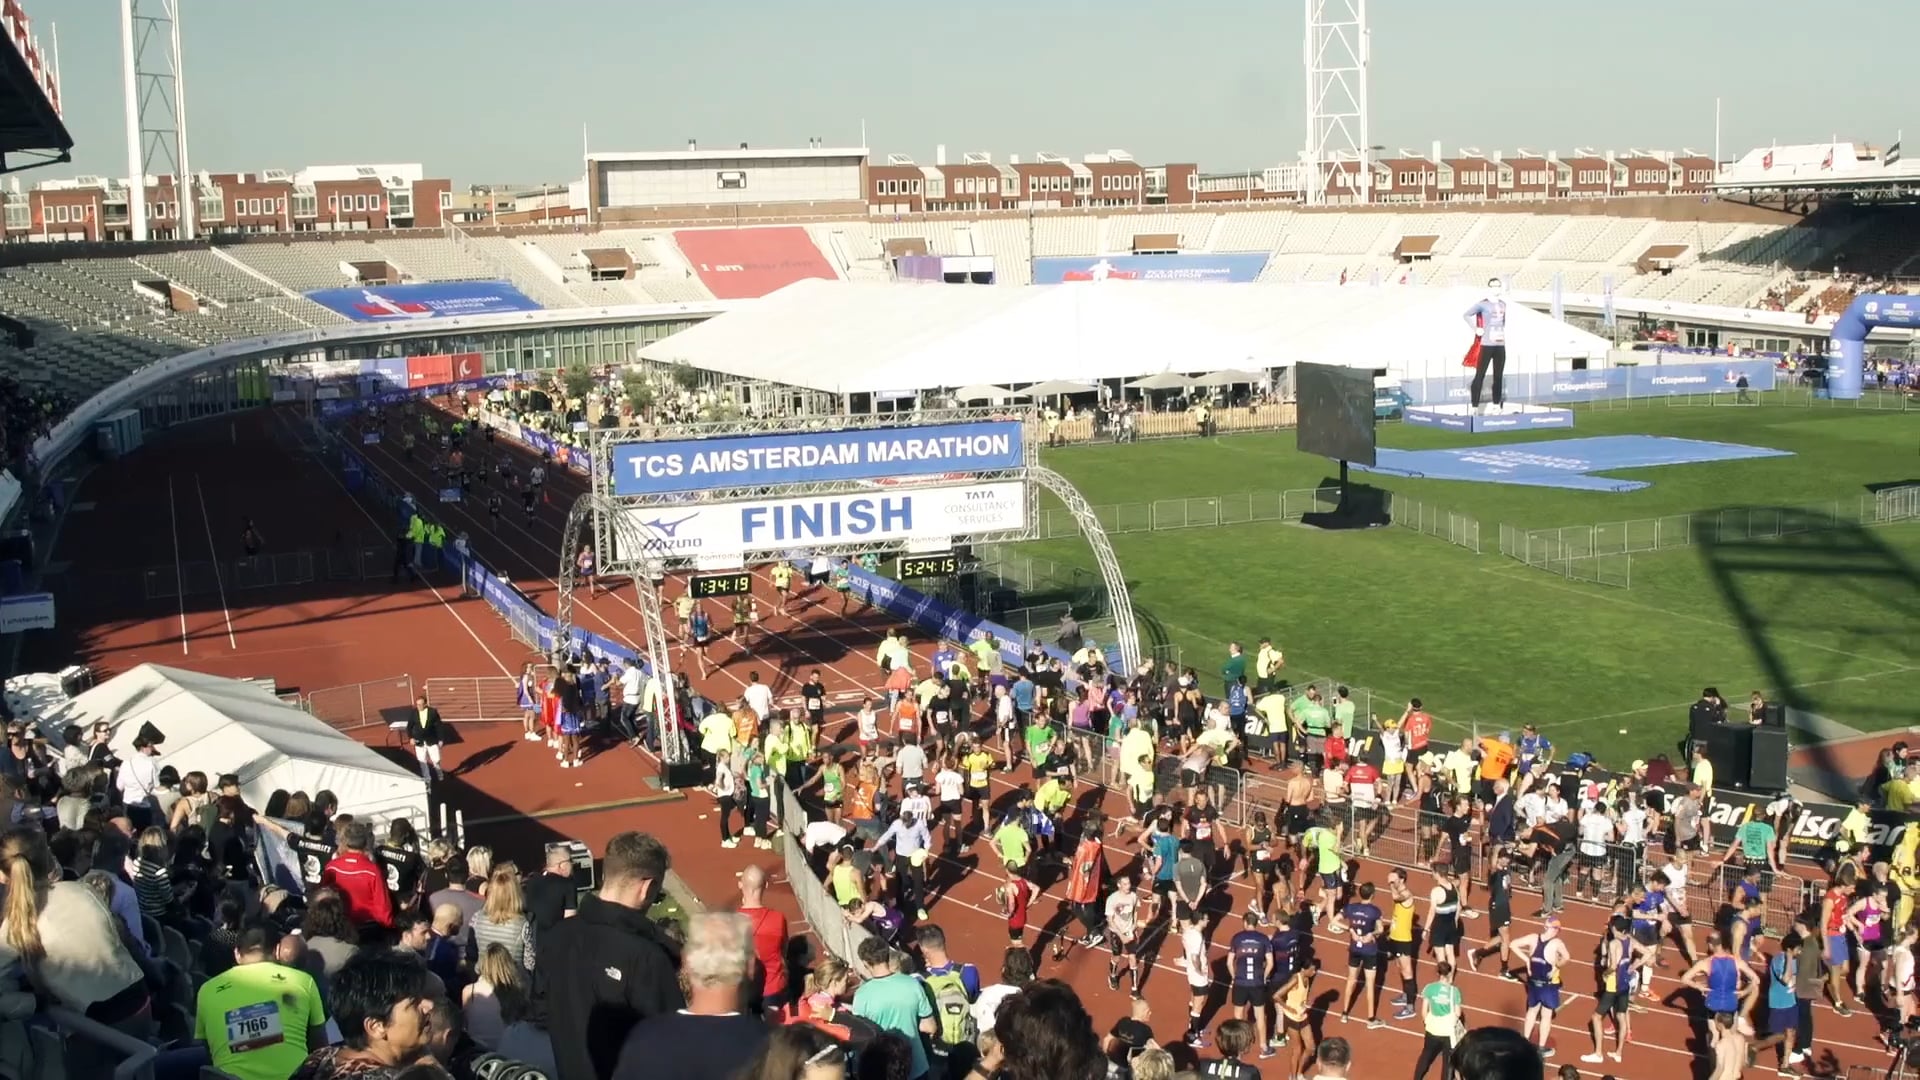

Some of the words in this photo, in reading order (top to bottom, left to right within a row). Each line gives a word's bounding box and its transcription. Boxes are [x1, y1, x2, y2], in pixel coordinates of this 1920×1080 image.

[629, 454, 683, 478] TCS
[690, 442, 859, 475] AMSTERDAM
[867, 434, 1009, 463] MARATHON
[965, 490, 994, 500] TATA
[944, 499, 1015, 514] CONSULTANCY
[741, 496, 913, 543] FINISH
[958, 513, 1003, 525] SERVICES
[904, 559, 954, 576] 5:24:15
[700, 577, 749, 594] 1:34:19
[237, 1016, 268, 1036] 7166
